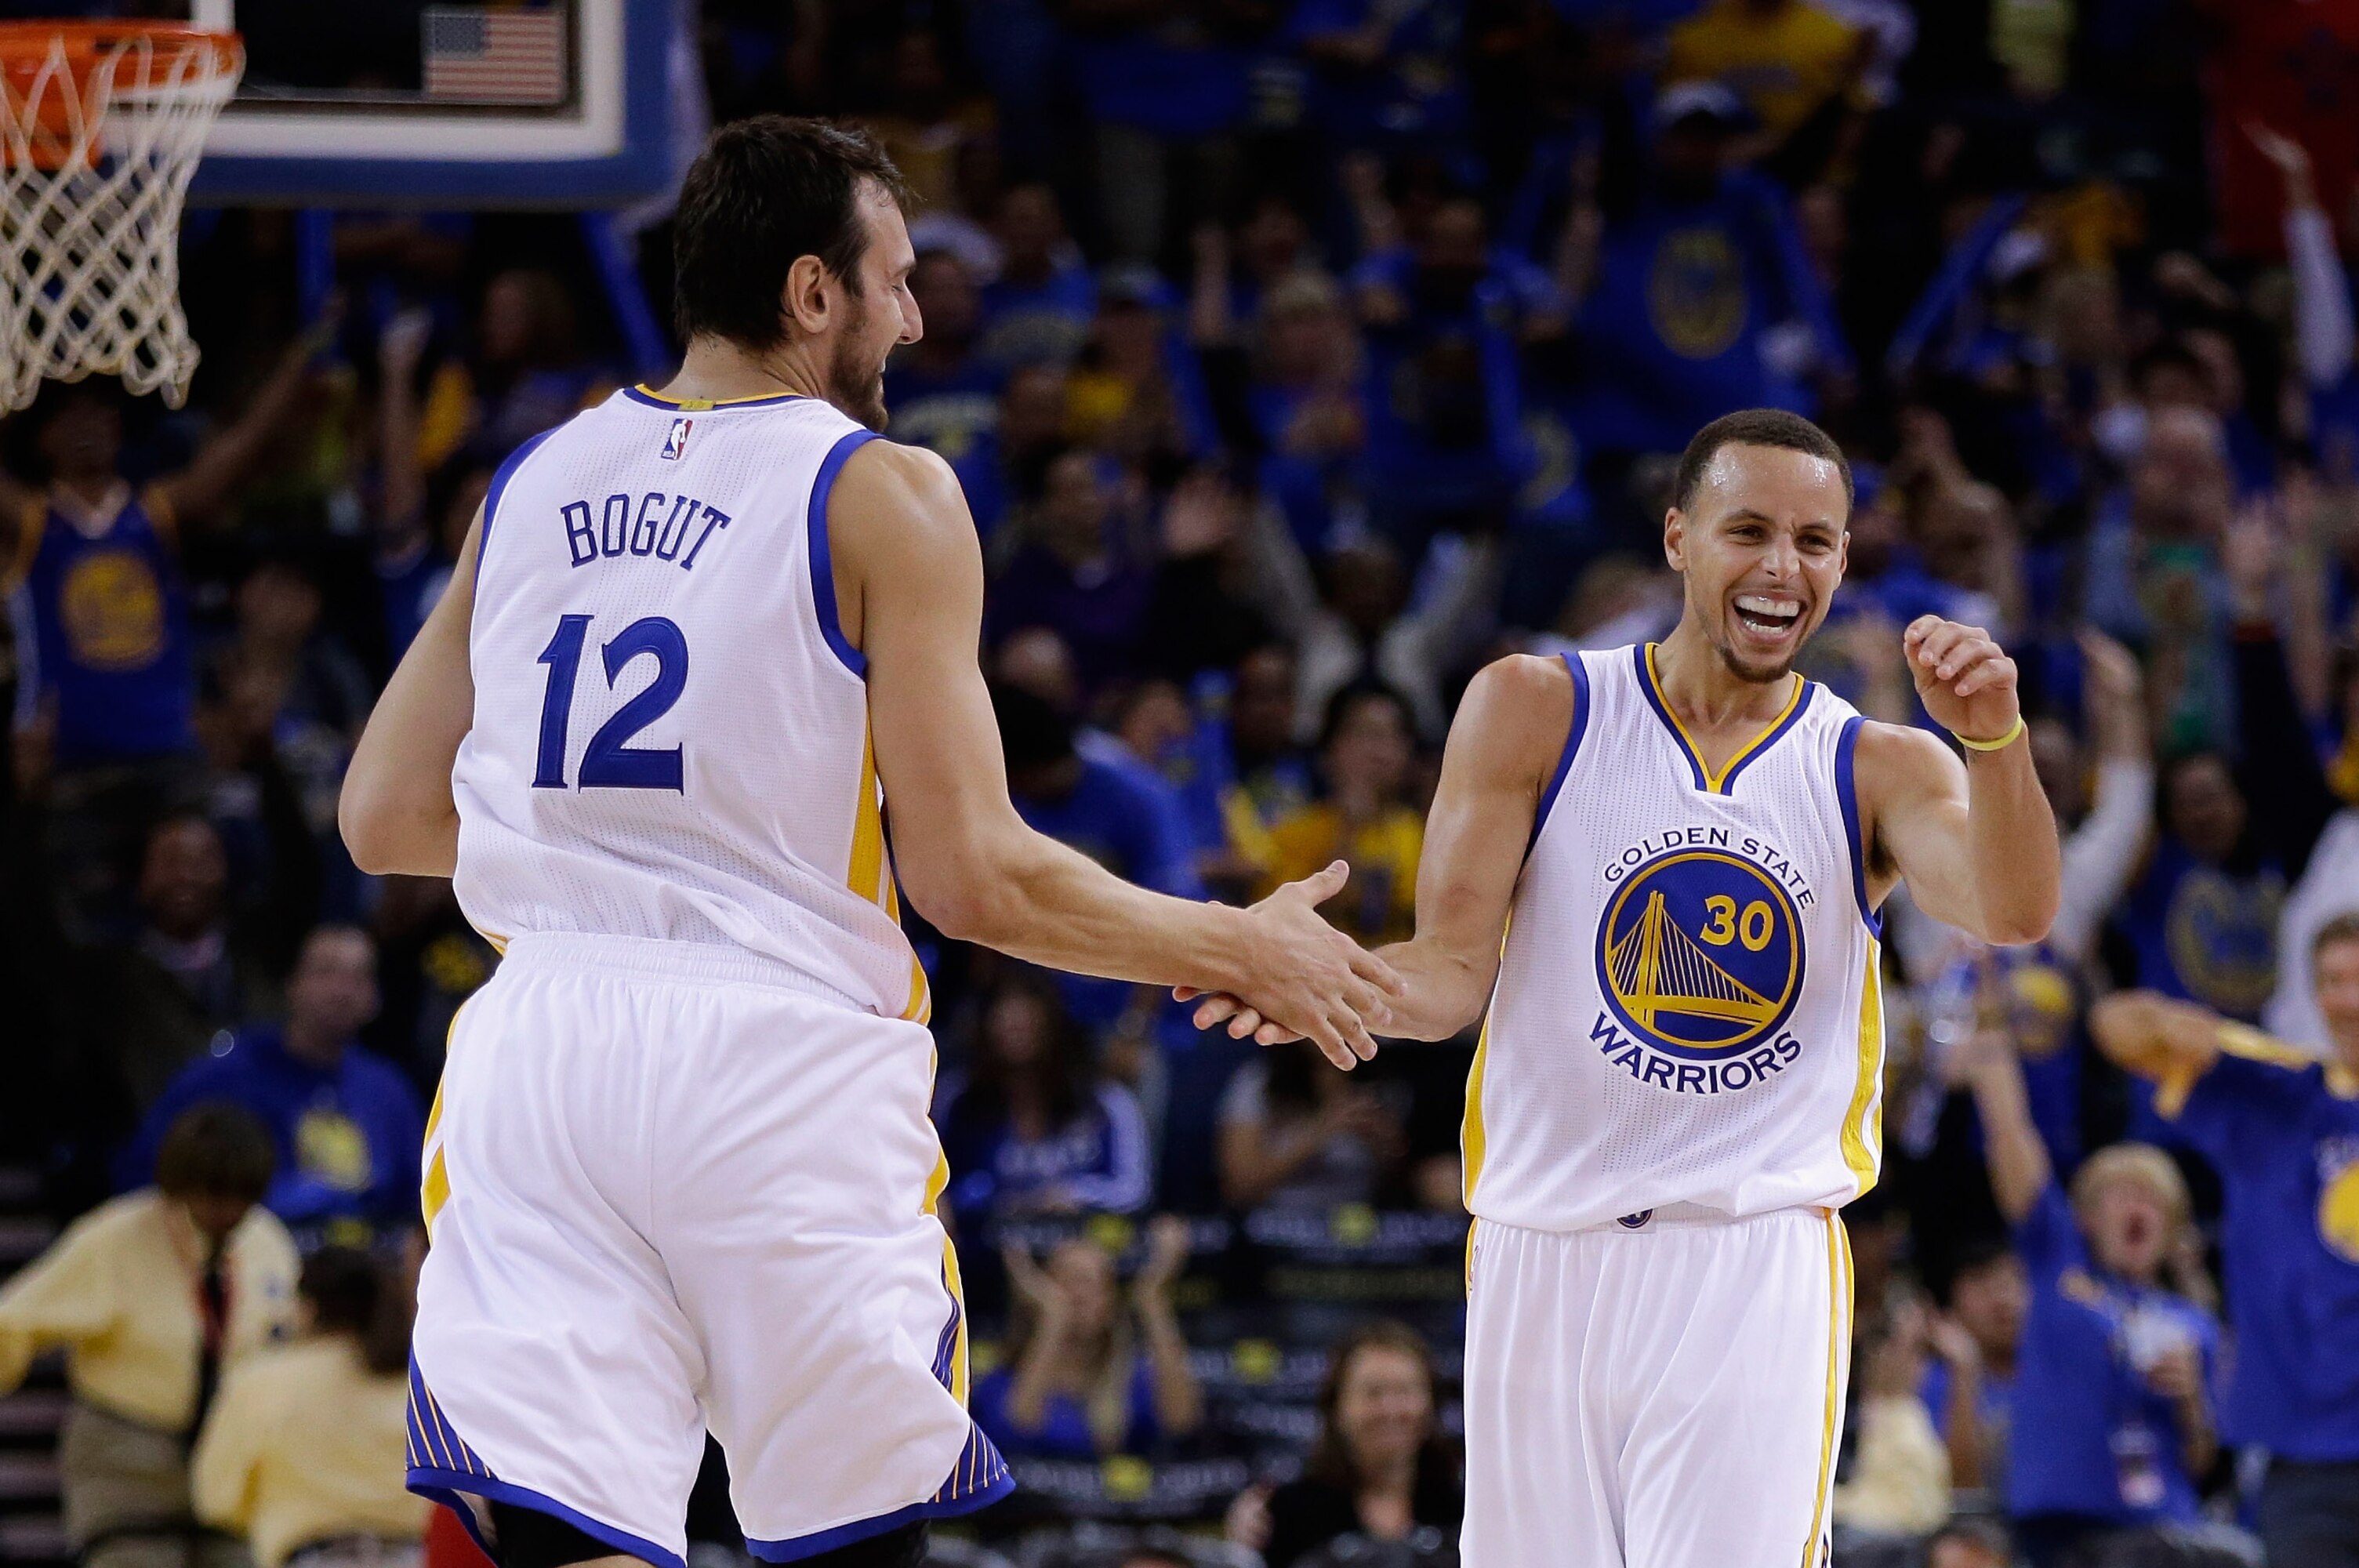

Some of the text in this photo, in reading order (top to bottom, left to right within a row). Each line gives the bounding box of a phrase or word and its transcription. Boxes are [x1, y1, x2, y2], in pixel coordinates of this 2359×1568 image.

[560, 492, 731, 572] BOGUT
[531, 614, 690, 797] 12
[1604, 827, 1815, 910] GOLDEN STATE
[1700, 895, 1774, 952] 30
[1589, 1011, 1802, 1094] WARRIORS
